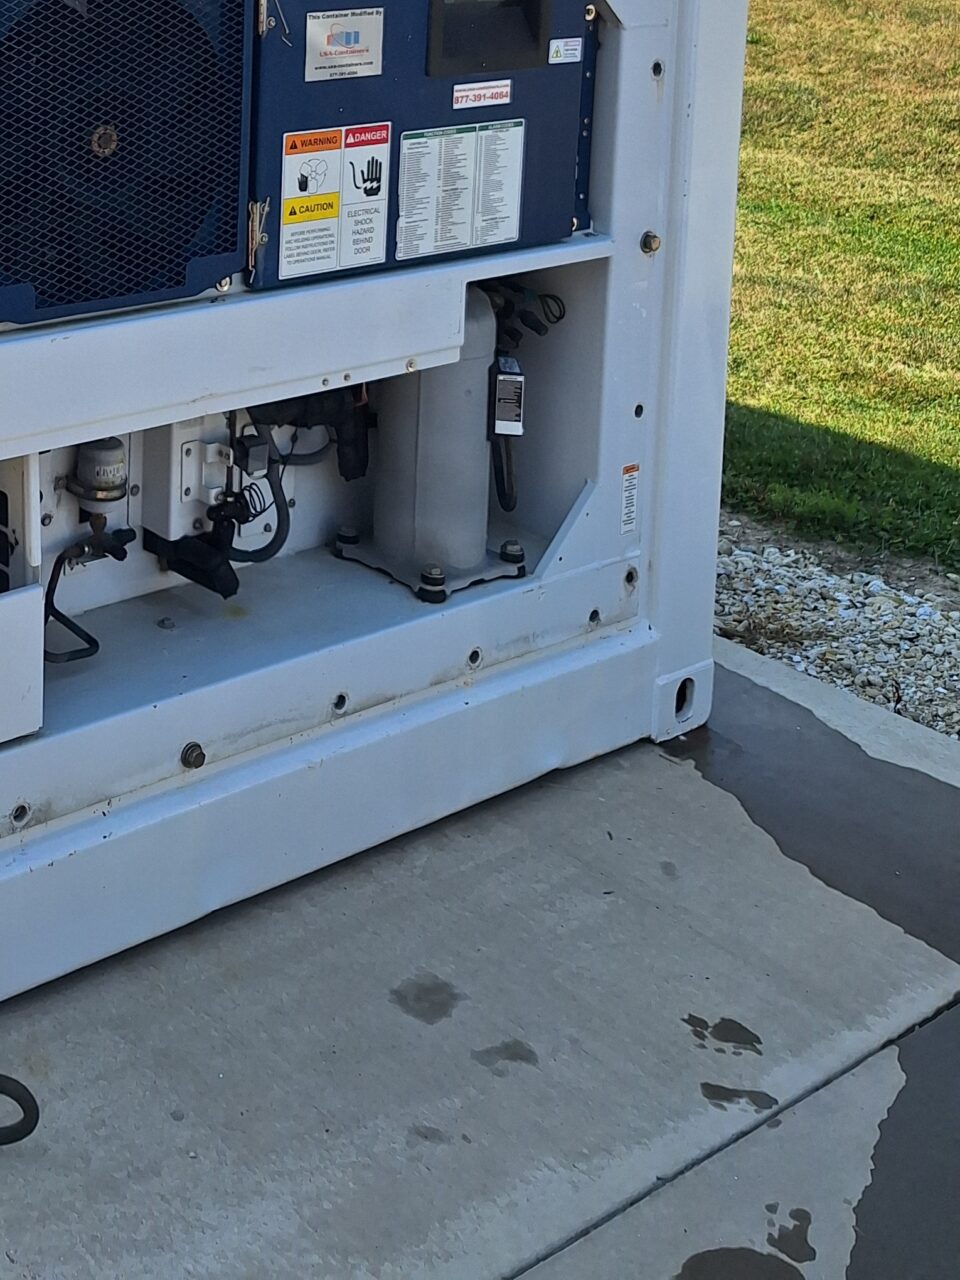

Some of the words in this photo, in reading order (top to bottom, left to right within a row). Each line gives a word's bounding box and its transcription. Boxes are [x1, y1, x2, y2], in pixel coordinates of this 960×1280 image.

[454, 90, 509, 104] 877-391-4064
[355, 130, 387, 142] DANGER
[300, 136, 338, 148] WARNING
[298, 202, 334, 214] CAUTION
[348, 208, 380, 218] ELECTRICAL
[354, 218, 373, 226] SHOCK
[352, 227, 374, 236] HAZARD
[352, 237, 373, 246] BEHIND
[354, 246, 370, 255] DOOR
